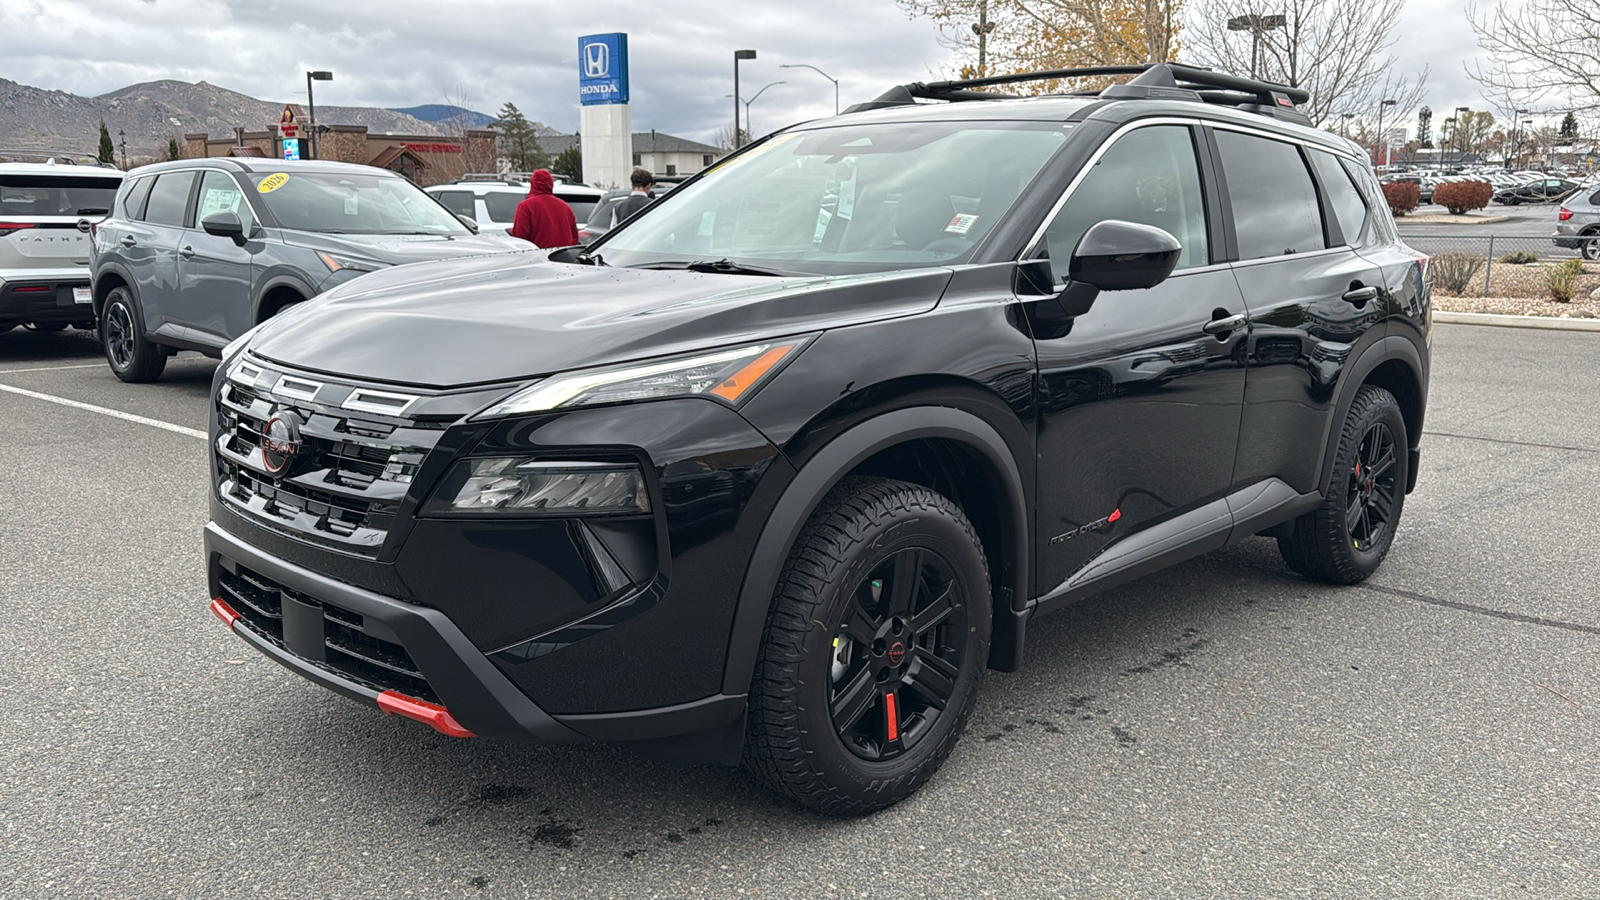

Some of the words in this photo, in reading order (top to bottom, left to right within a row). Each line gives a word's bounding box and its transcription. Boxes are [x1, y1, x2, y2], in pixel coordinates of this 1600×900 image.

[580, 84, 619, 95] HONDA
[263, 174, 285, 190] 2026
[263, 438, 295, 455] SSAN
